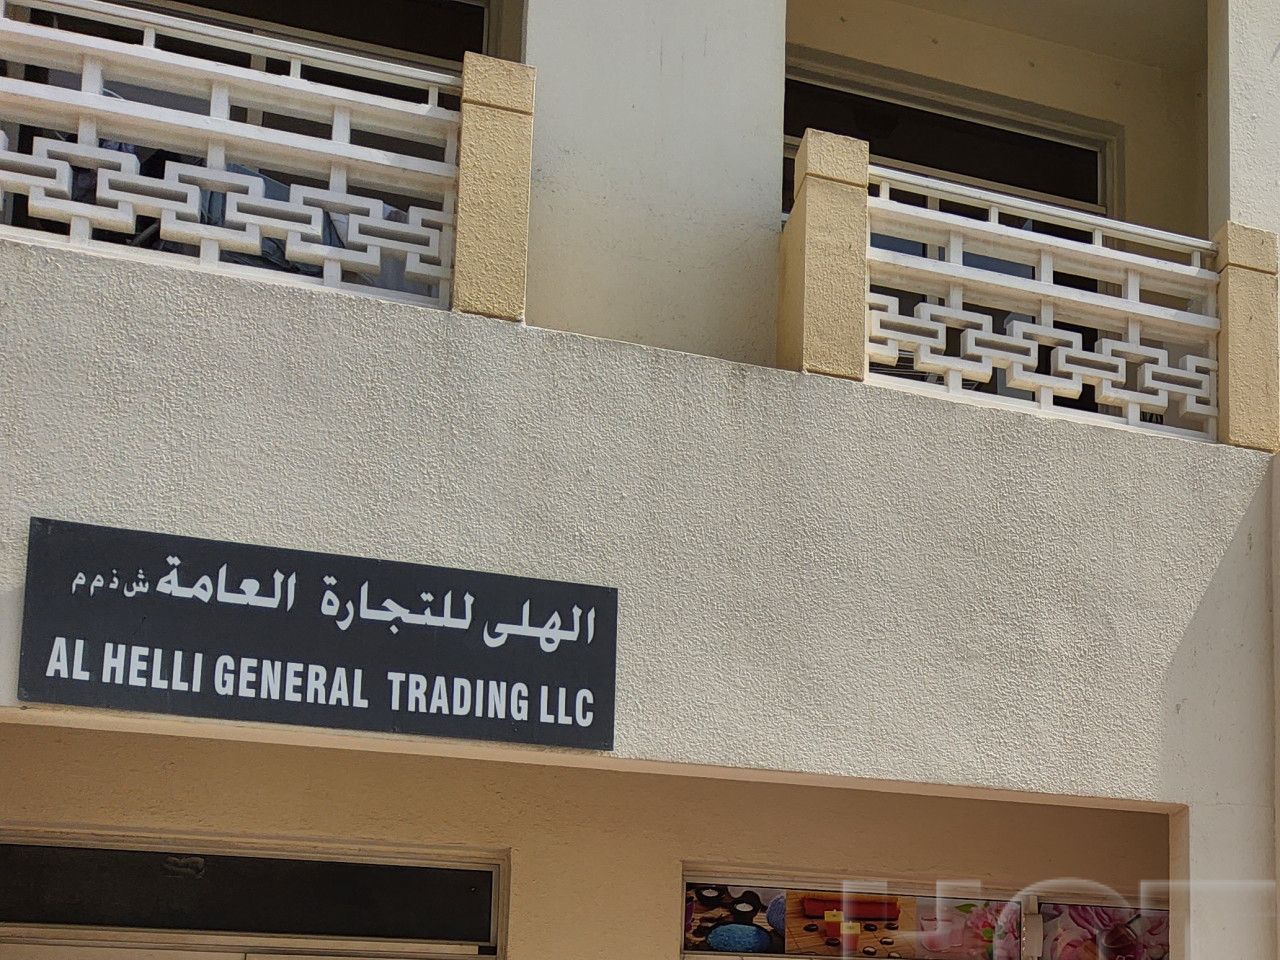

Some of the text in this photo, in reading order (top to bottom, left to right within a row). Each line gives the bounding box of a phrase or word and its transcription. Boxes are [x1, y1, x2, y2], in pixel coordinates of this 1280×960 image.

[156, 555, 297, 612] العامة
[321, 575, 475, 634] للتجارة
[45, 637, 594, 727] AL HELLI GENERAL TRADING LLC
